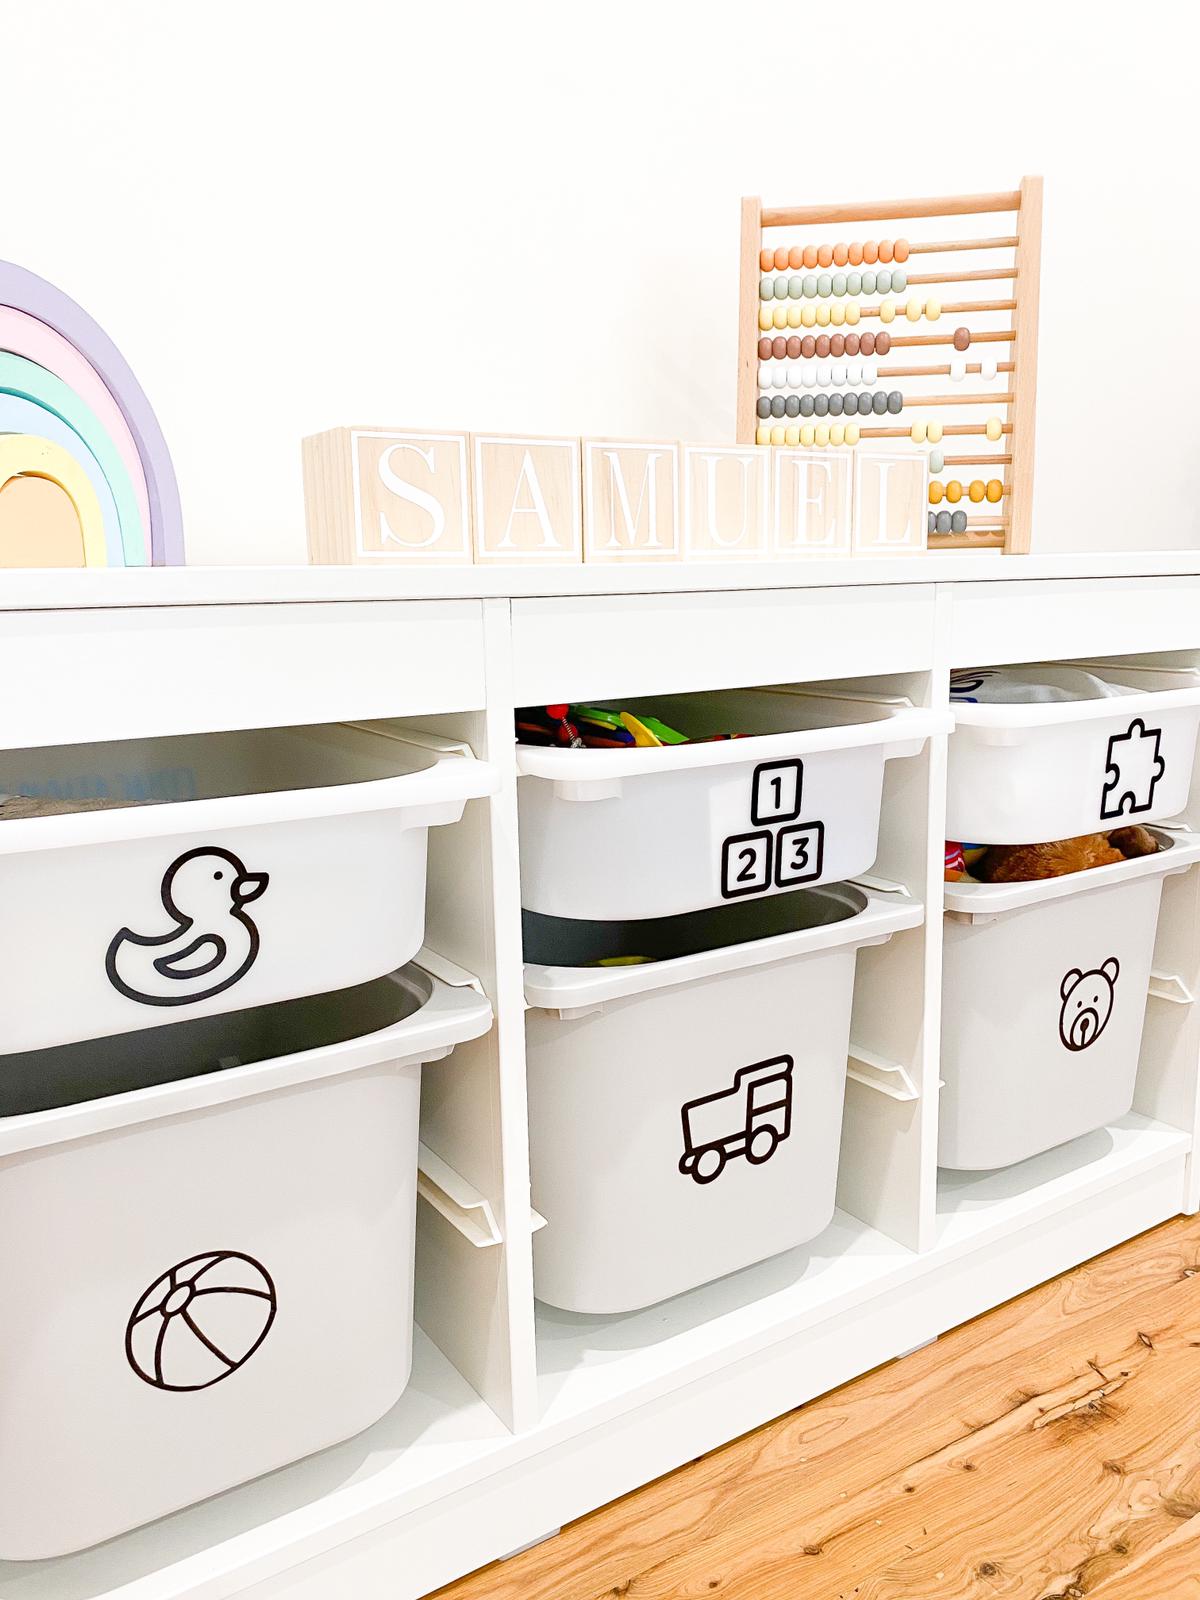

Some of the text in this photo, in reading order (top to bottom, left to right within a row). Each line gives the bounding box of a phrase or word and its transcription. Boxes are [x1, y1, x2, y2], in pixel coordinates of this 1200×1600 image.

[377, 443, 913, 548] SAMUEL
[770, 776, 782, 810] 1
[736, 836, 810, 882] 2 3
